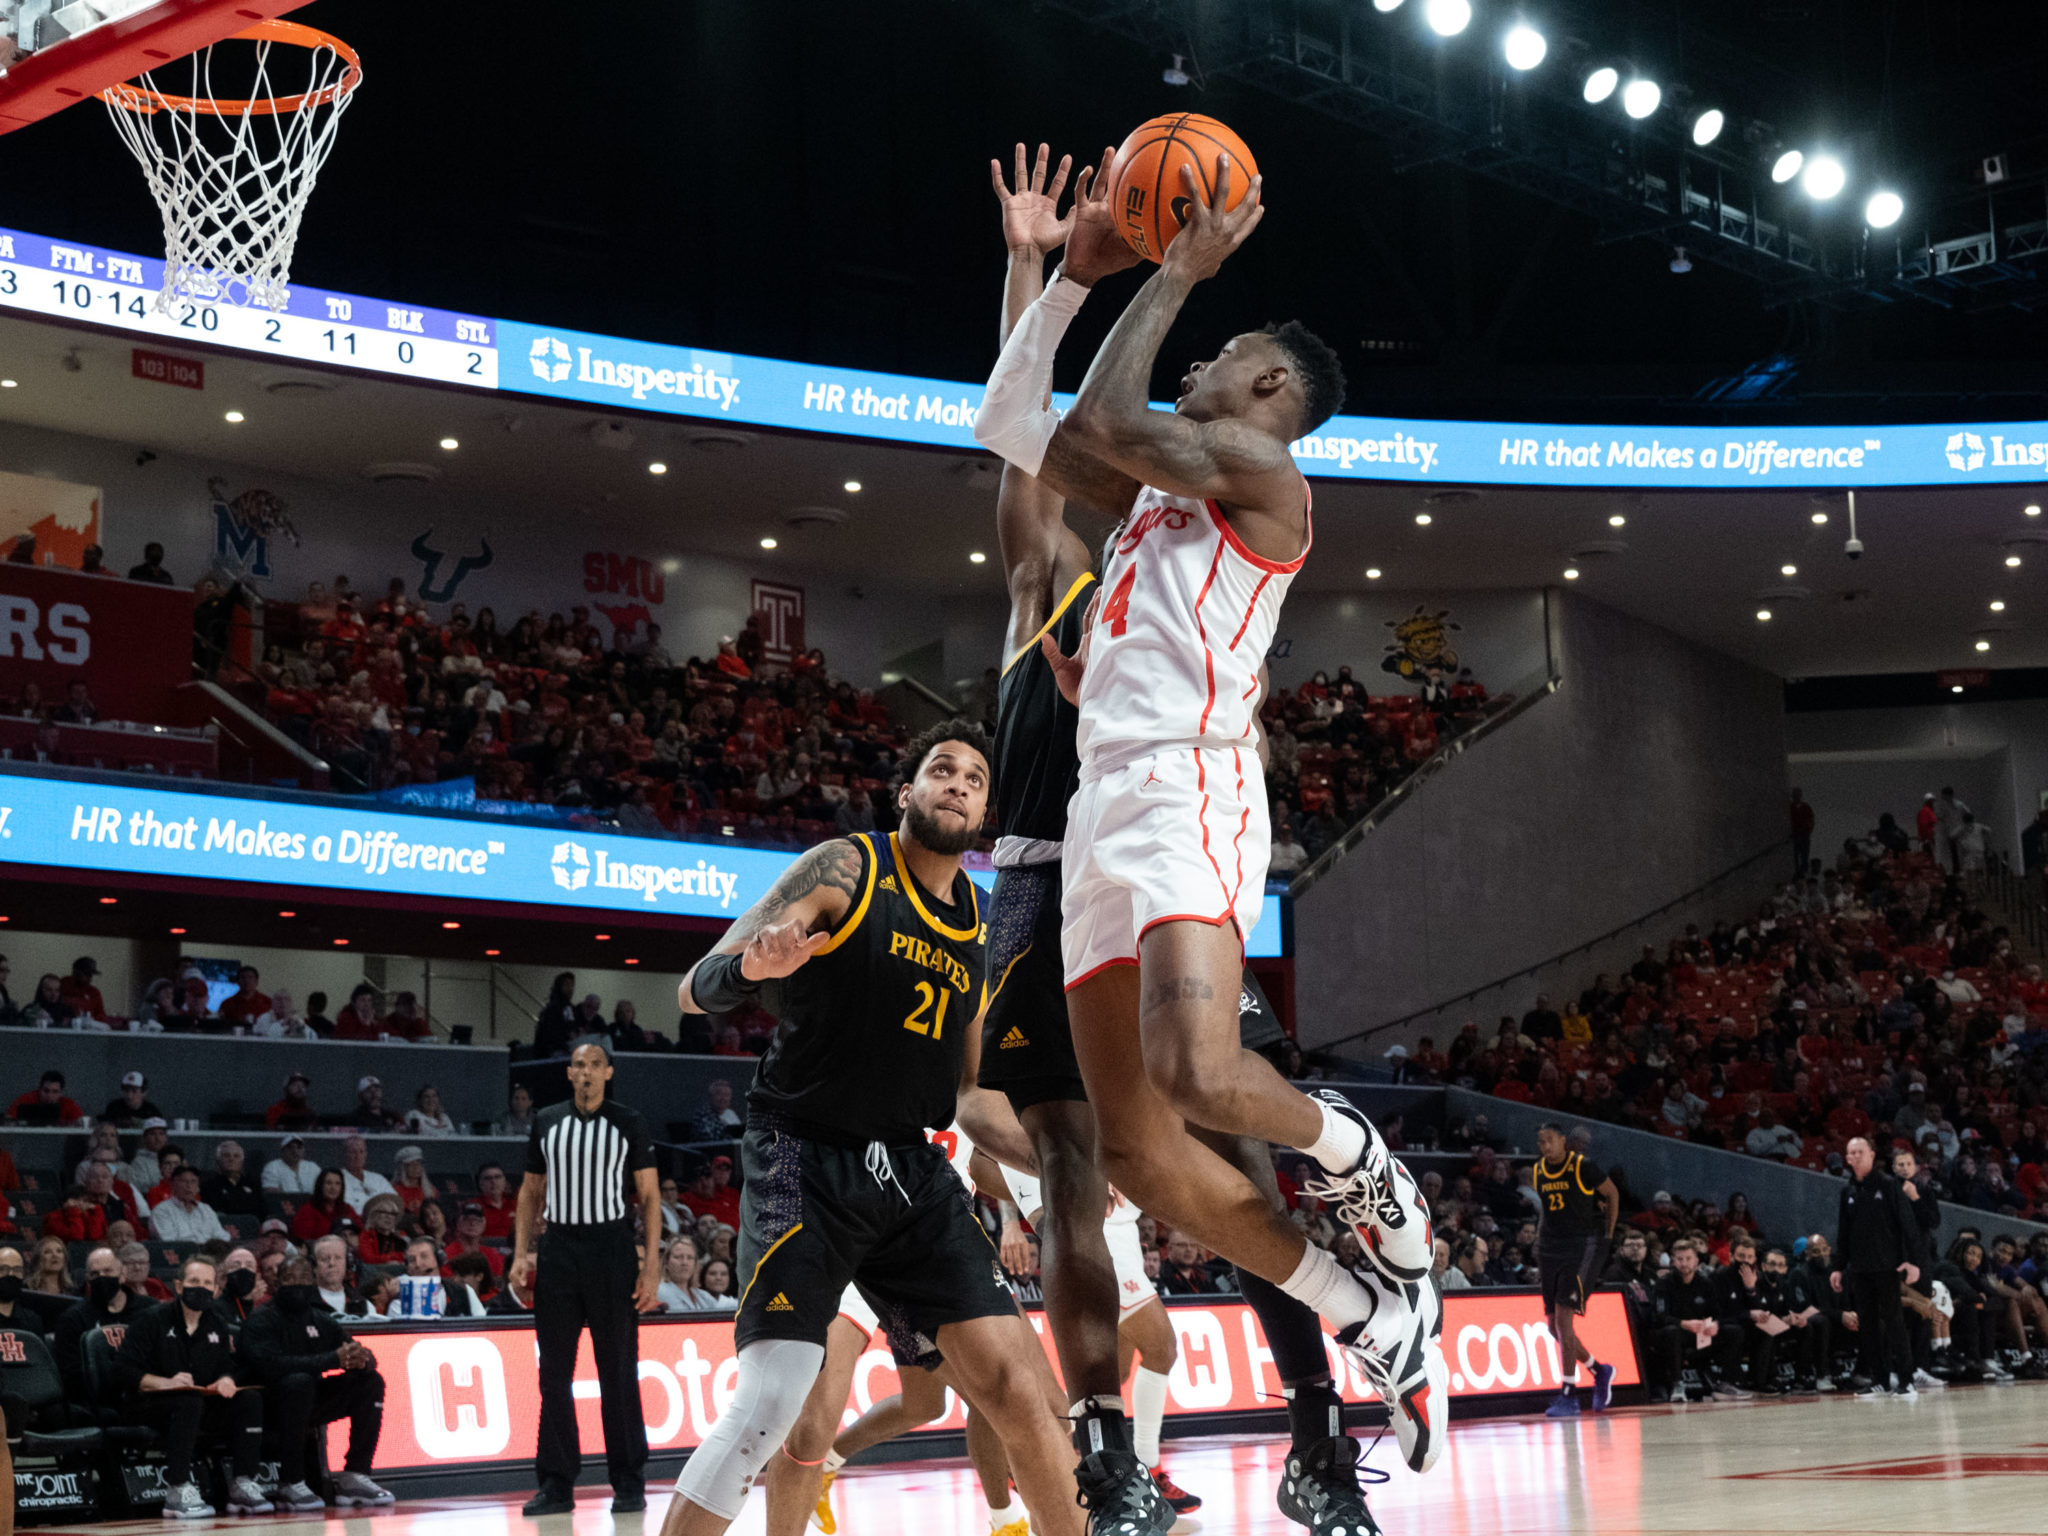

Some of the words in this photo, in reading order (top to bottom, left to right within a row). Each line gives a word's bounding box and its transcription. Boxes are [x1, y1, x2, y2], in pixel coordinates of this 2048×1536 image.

[1126, 186, 1152, 257] ELITE
[180, 304, 219, 331] 20
[265, 318, 281, 342] 2
[324, 329, 357, 355] 11
[398, 341, 414, 364] 0
[467, 352, 482, 375] 2
[326, 297, 351, 321] TO
[388, 307, 423, 334] BLK
[456, 320, 490, 345] STL
[804, 381, 846, 414] HR
[851, 387, 908, 419] that
[1499, 438, 1538, 466] HR
[1545, 439, 1601, 467] that
[1607, 440, 1694, 468] Makes
[1700, 447, 1717, 468] a
[213, 502, 272, 580] M
[583, 552, 664, 605] SMU
[1101, 562, 1136, 638] 4
[71, 805, 121, 844] HR
[129, 809, 198, 850] that
[203, 818, 306, 860] Makes
[312, 834, 331, 862] a
[888, 930, 970, 994] PIRATES
[903, 981, 951, 1040] 21
[1000, 1038, 1030, 1049] adidas
[1548, 1193, 1565, 1211] 23
[765, 1302, 794, 1312] adidas
[18, 1494, 84, 1508] chiropractic
[34, 1474, 79, 1496] JOINT
